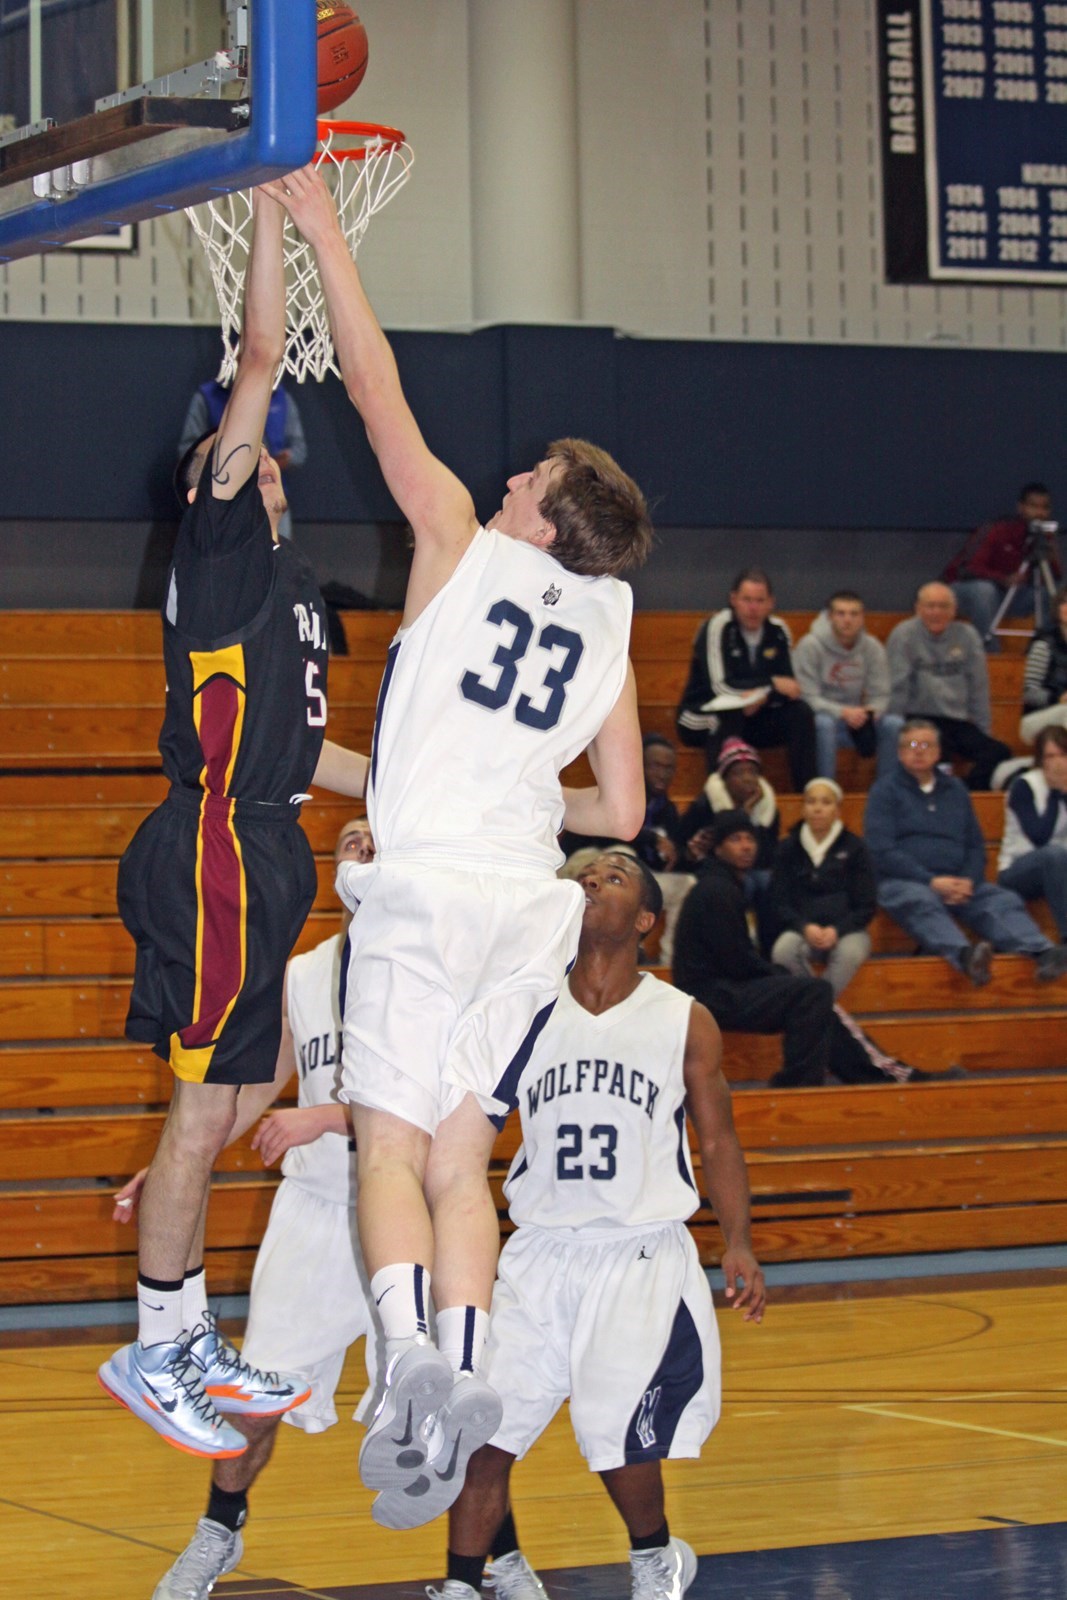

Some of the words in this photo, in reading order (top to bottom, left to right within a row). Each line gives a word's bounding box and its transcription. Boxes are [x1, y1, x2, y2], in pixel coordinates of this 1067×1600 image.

[887, 12, 916, 153] BASEBALL
[457, 596, 586, 733] 33
[527, 1059, 660, 1120] WOLFPACK
[557, 1124, 618, 1180] 23
